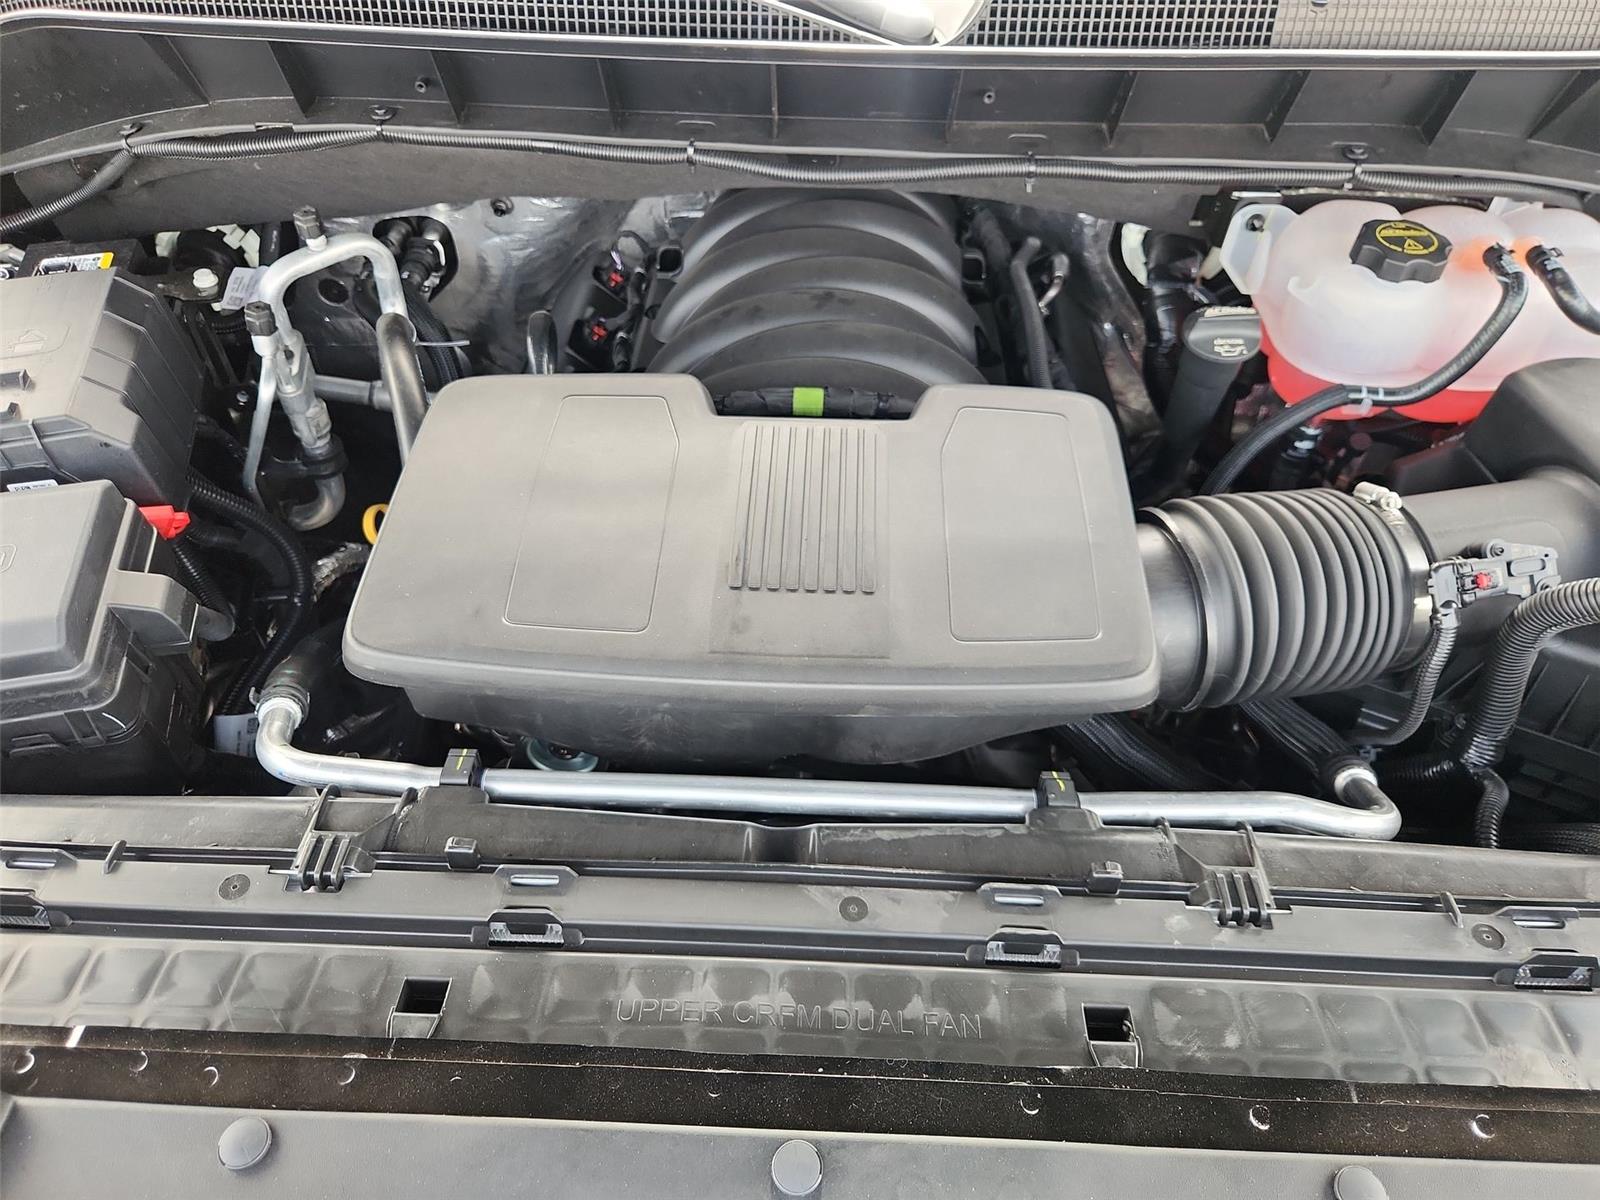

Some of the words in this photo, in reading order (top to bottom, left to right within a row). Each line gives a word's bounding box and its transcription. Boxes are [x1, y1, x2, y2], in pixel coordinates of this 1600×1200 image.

[616, 998, 723, 1023] UPPER
[732, 1000, 822, 1030] CRFM
[831, 1006, 914, 1036] DUAL
[922, 1011, 983, 1040] FAN
